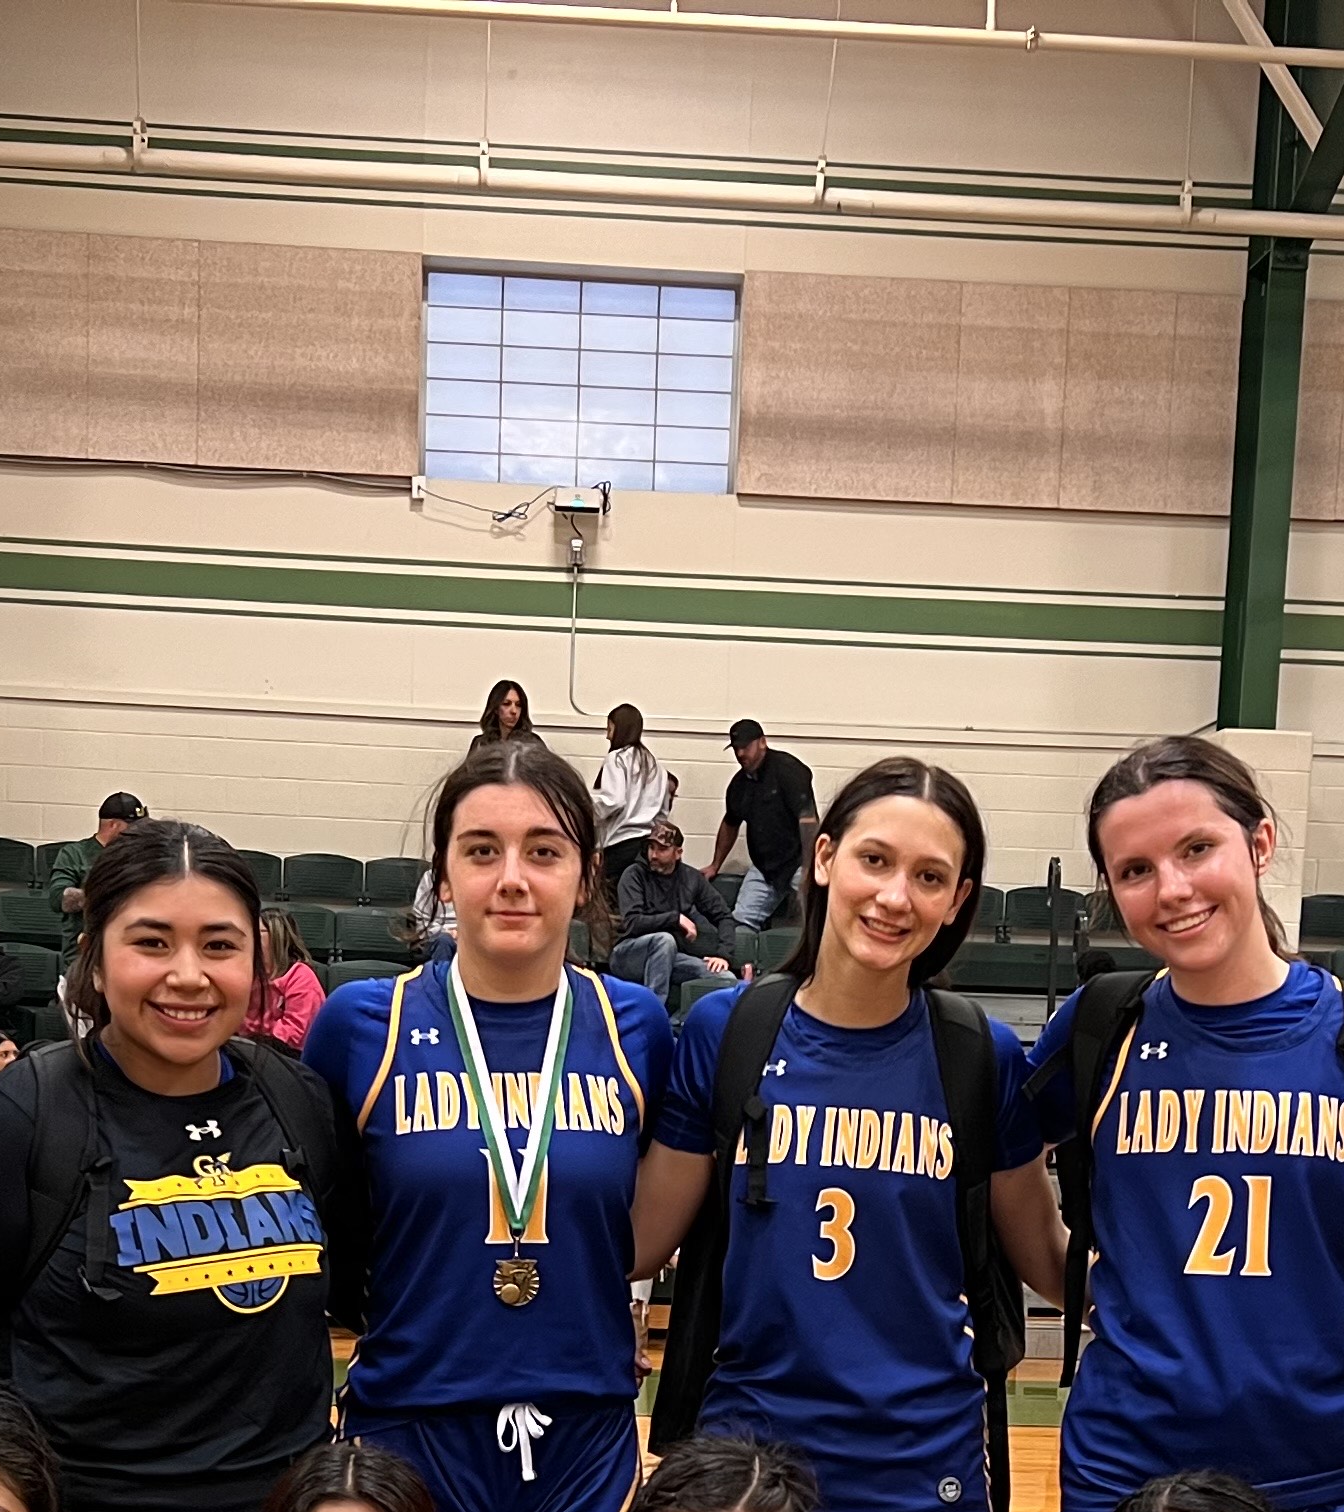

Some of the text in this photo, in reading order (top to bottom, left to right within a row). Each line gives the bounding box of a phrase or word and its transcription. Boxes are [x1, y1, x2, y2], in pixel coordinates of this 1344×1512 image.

[819, 1106, 954, 1180] INDIANS
[1116, 1089, 1205, 1155] LADY
[109, 1190, 324, 1267] INDIANS
[811, 1187, 856, 1281] 3
[1183, 1175, 1272, 1277] 21
